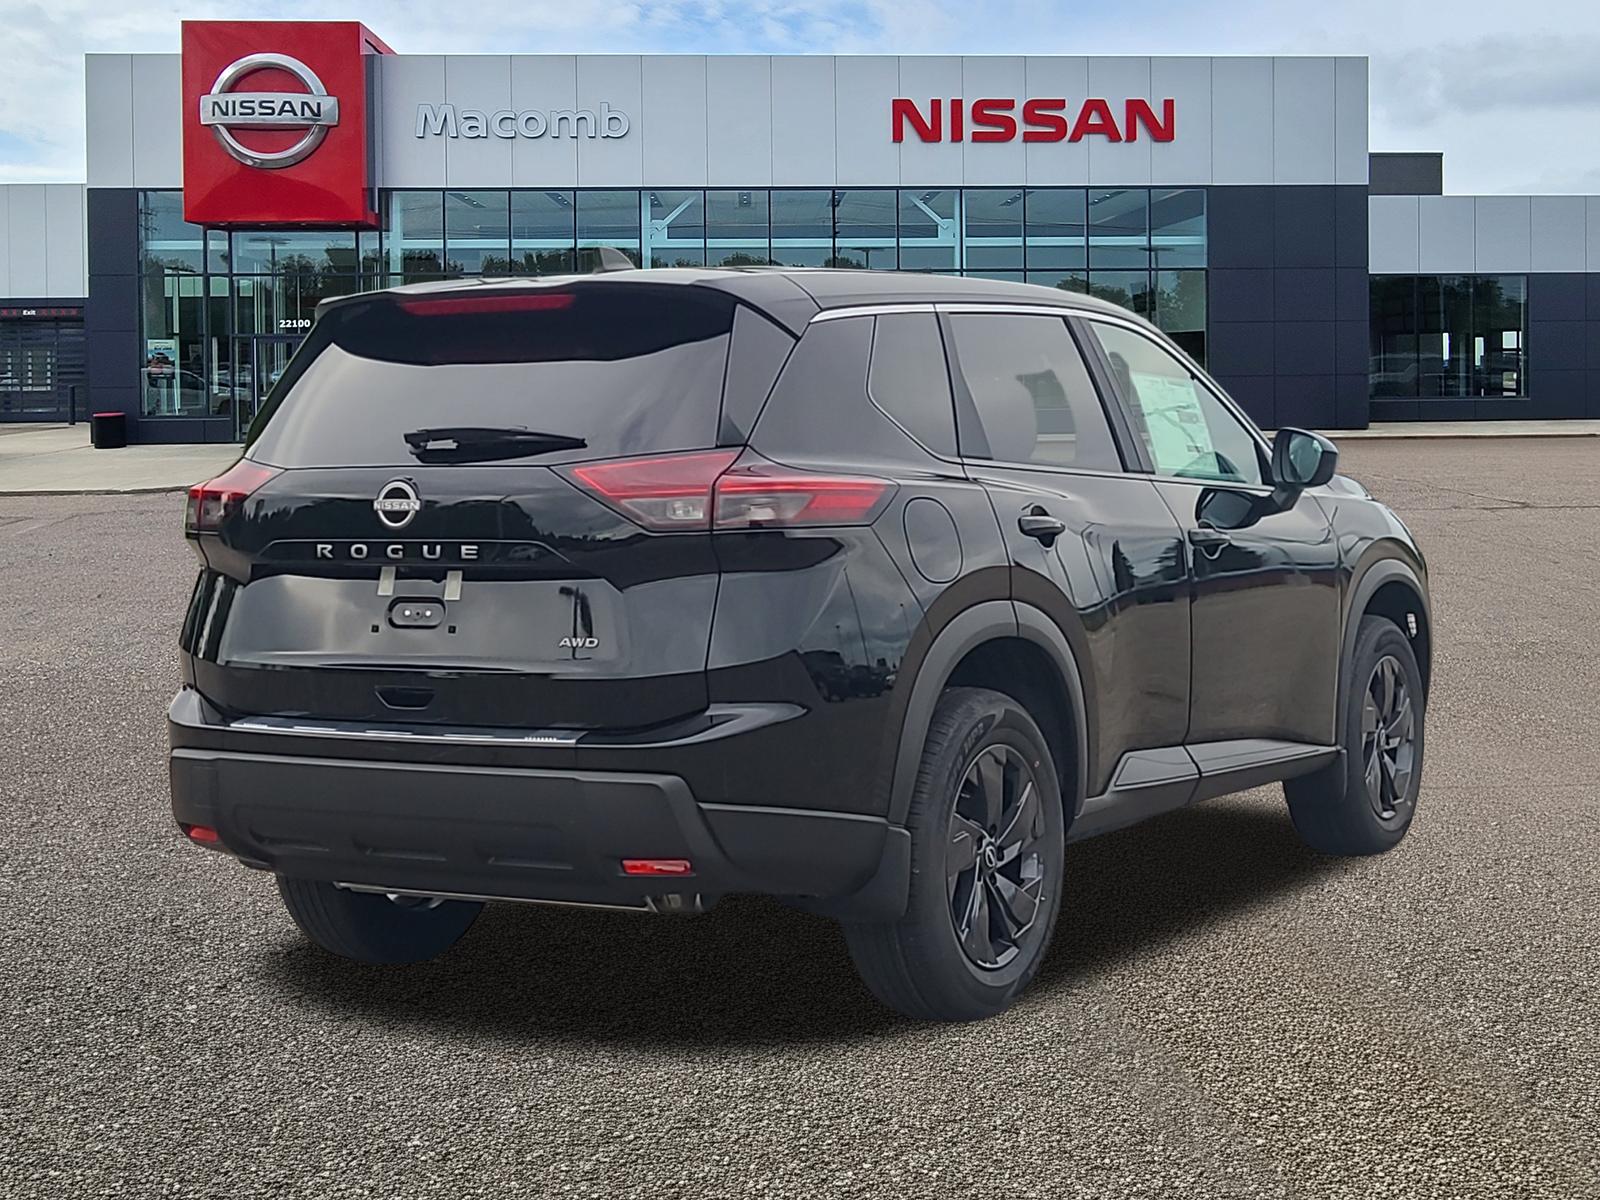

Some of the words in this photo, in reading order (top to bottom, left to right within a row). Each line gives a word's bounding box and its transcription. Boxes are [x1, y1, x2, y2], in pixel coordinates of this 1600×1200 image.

[212, 100, 321, 117] NISSAN
[415, 102, 630, 139] Macomb
[892, 98, 1175, 143] NISSAN
[279, 319, 311, 328] 22100
[374, 500, 420, 511] NISSAN
[317, 544, 478, 559] ROGUE
[559, 637, 598, 648] AWD
